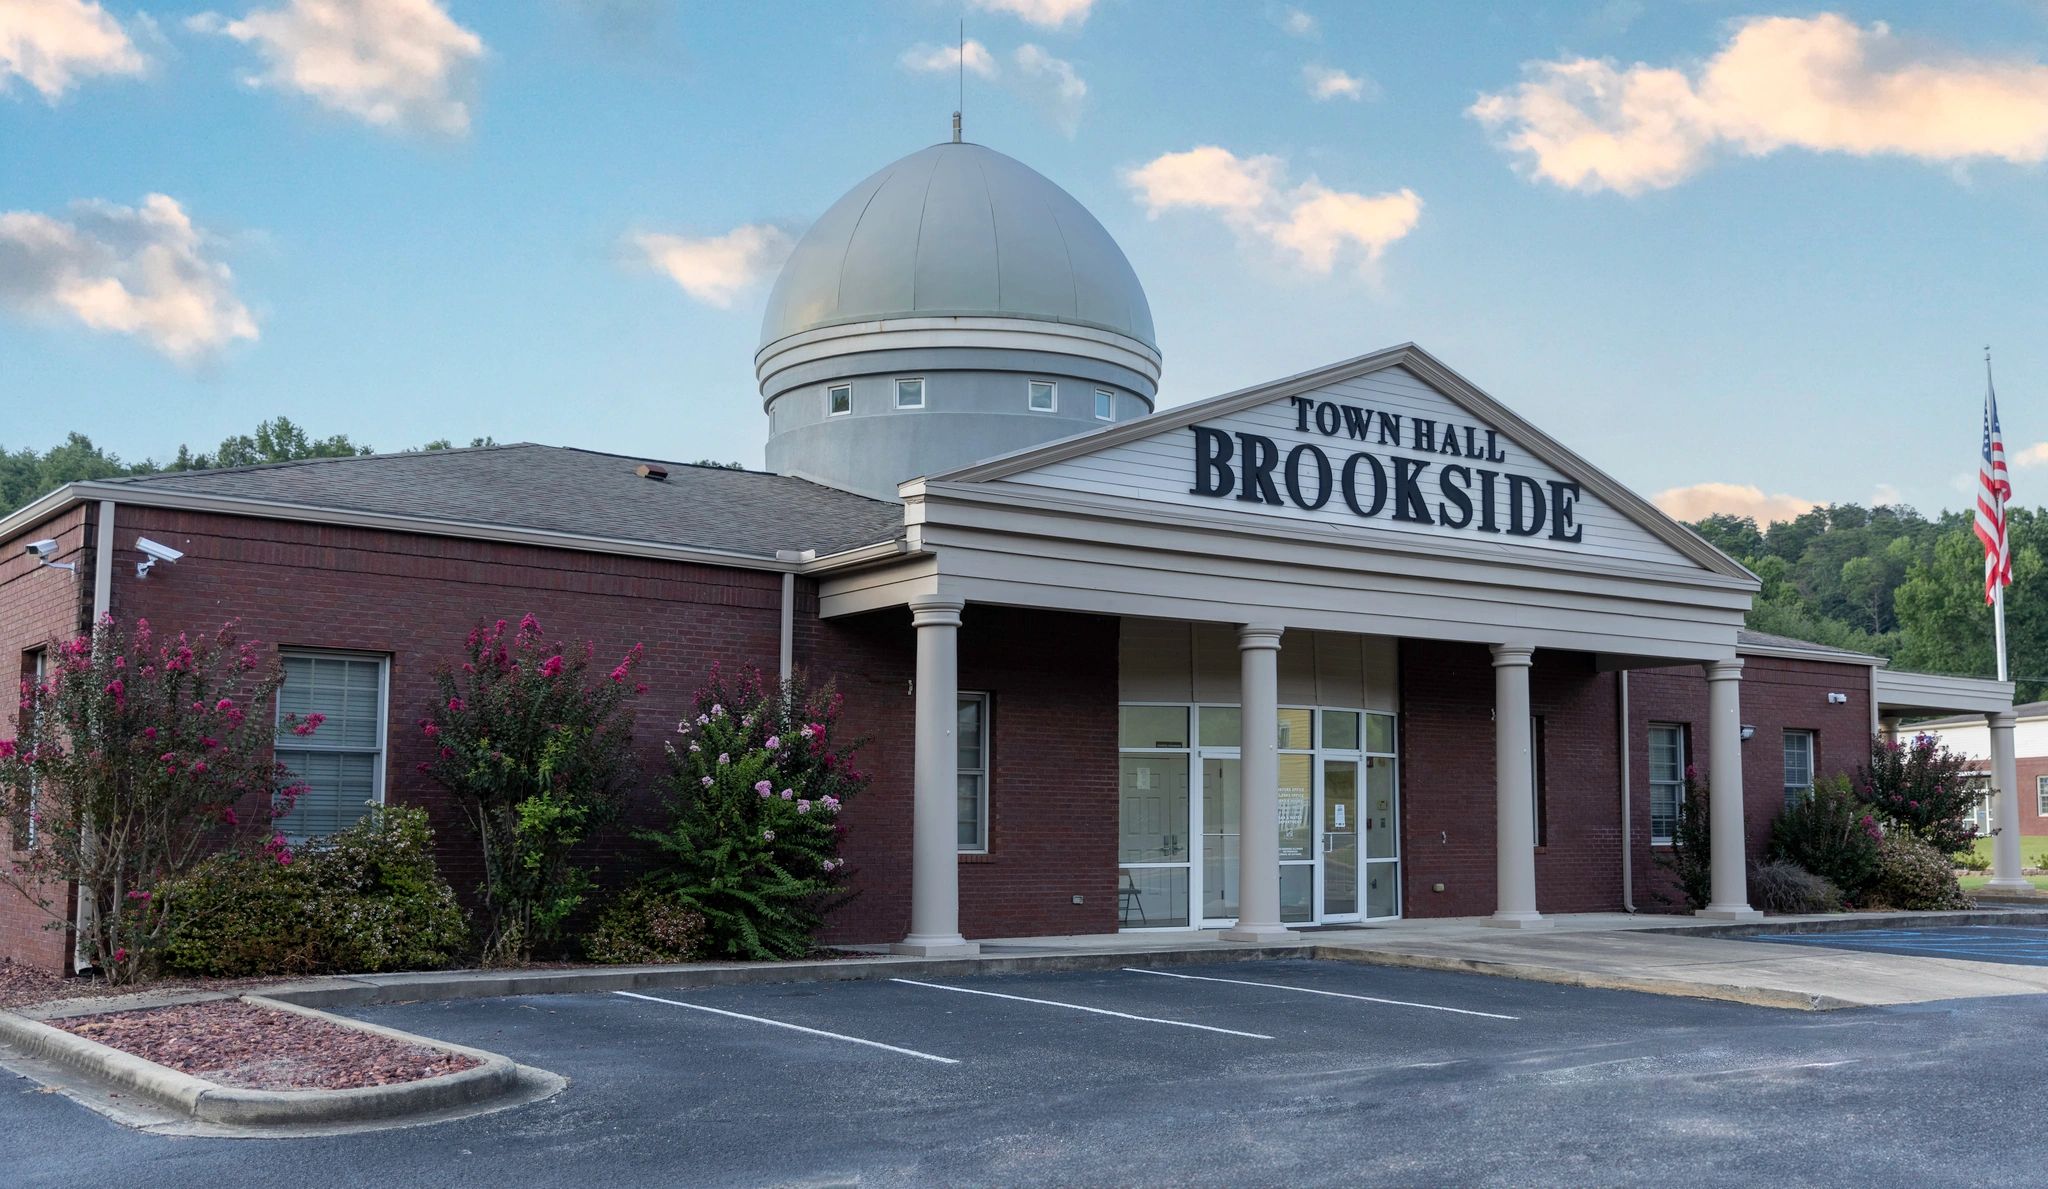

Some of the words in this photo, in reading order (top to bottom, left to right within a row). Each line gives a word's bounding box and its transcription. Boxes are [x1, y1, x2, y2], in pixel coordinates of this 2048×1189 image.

[1291, 396, 1401, 447] TOWN
[1412, 417, 1505, 463] HALL
[1189, 424, 1583, 543] BROOKSIDE
